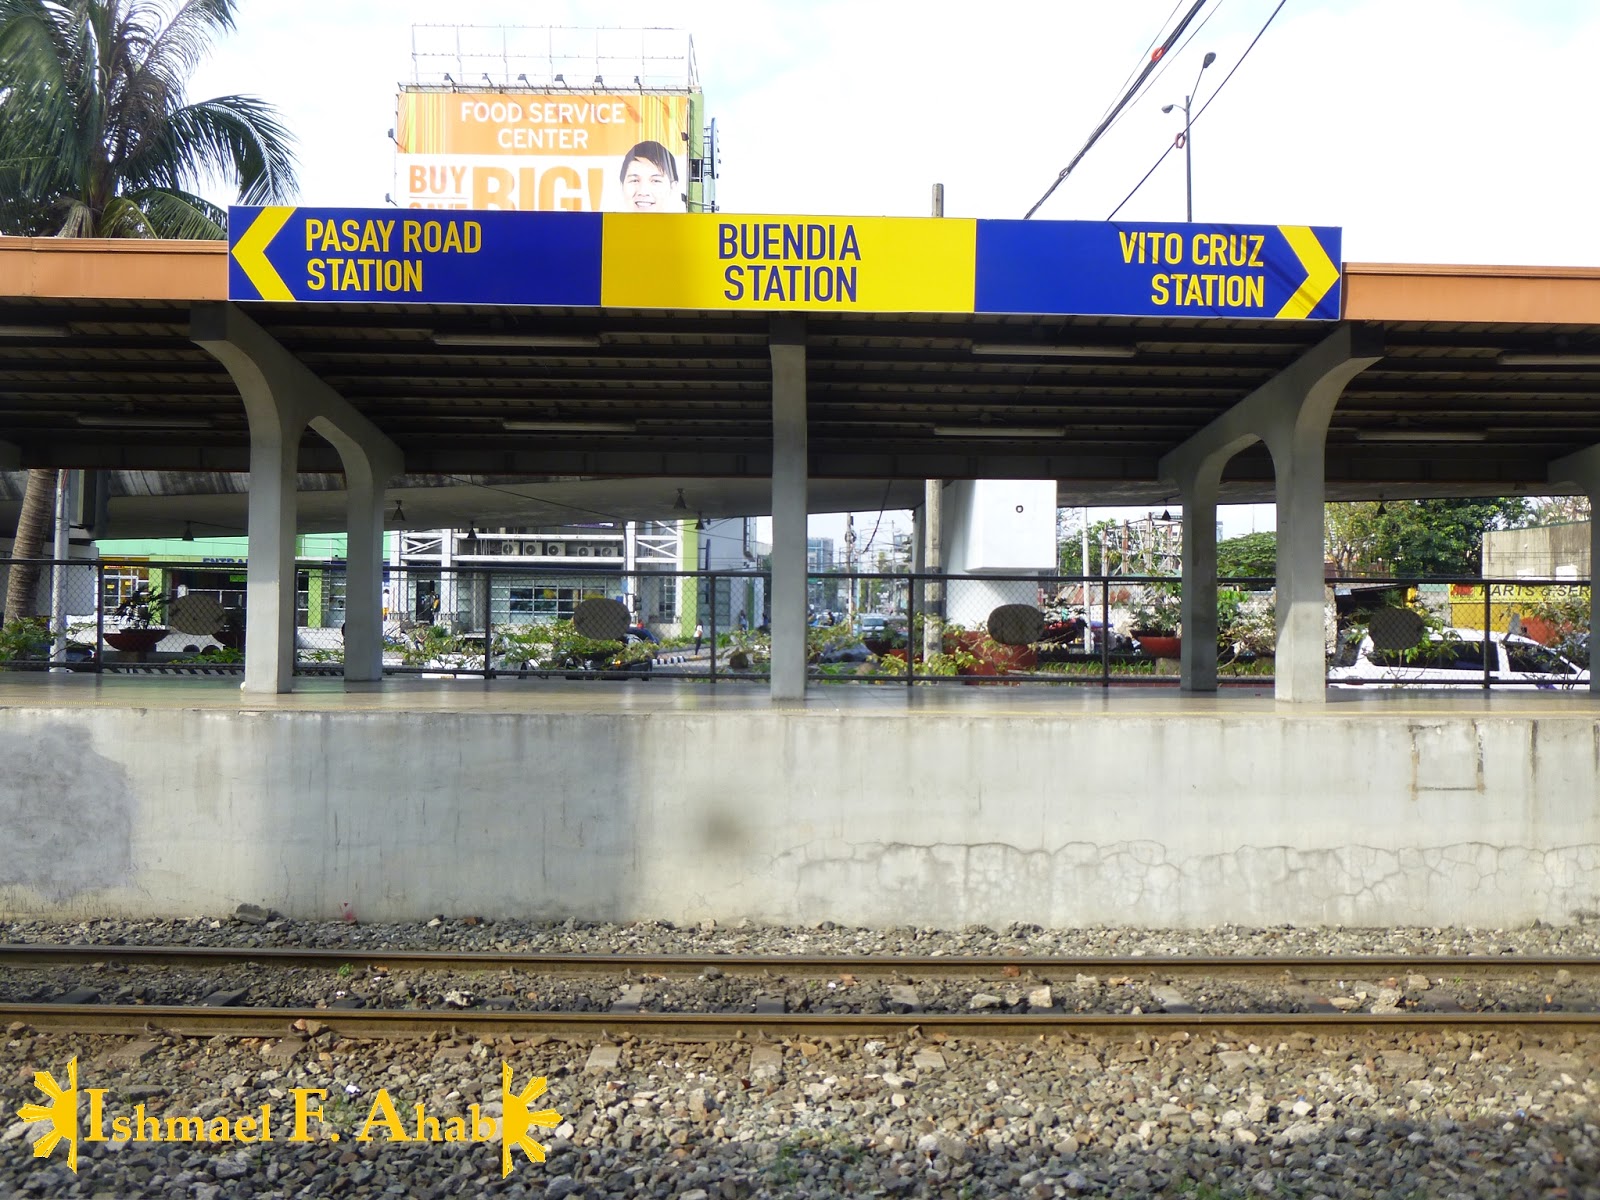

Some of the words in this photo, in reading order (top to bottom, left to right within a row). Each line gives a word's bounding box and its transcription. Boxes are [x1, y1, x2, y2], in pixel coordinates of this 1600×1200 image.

[461, 102, 522, 122] FOOD
[529, 103, 625, 123] SERVICE
[498, 128, 588, 148] CENTER
[409, 165, 467, 193] BUY
[472, 166, 604, 211] BIG!
[305, 219, 395, 252] PASAY
[403, 220, 482, 253] ROAD
[718, 223, 861, 261] BUENDIA
[1119, 231, 1183, 265] VITO
[1192, 233, 1265, 267] CRUZ
[307, 258, 423, 292] STATION
[724, 265, 857, 302] STATION
[1151, 273, 1265, 308] STATION
